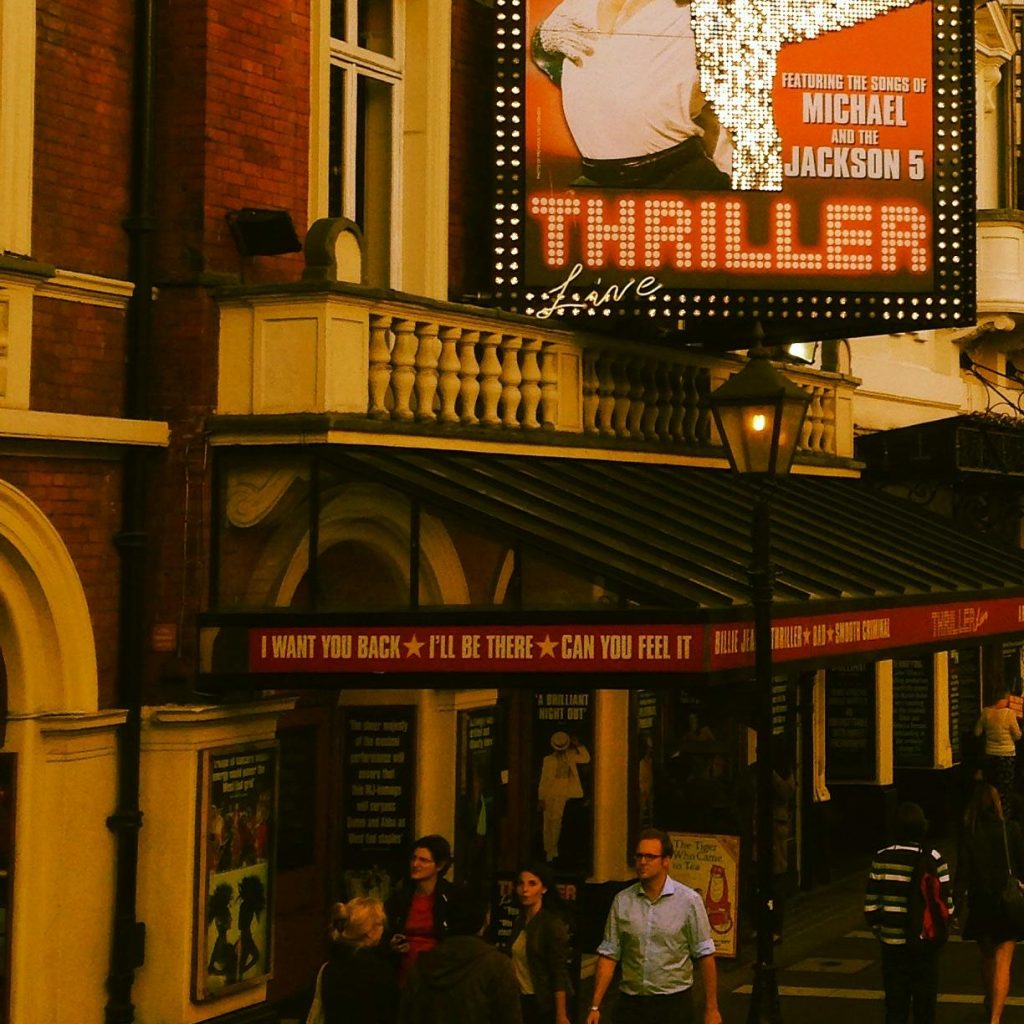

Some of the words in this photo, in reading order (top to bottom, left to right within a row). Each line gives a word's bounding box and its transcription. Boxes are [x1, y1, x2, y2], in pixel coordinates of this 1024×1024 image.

[782, 73, 844, 90] FEATURING
[847, 75, 867, 91] THE
[871, 76, 910, 93] SONGS
[914, 78, 926, 93] OF
[803, 93, 907, 127] MICHAEL
[831, 129, 855, 144] AND
[860, 130, 880, 145] THE
[785, 146, 900, 180] JACKSON
[908, 150, 925, 180] 5
[531, 195, 930, 273] THRILLER
[536, 263, 662, 320] Live
[715, 628, 738, 655] BILLIE
[741, 628, 756, 653] JEA
[771, 625, 802, 650] THRILLER
[835, 621, 861, 644] SMOOTH
[862, 617, 891, 641] CRIMINAL
[931, 608, 975, 638] THRILLER
[261, 635, 268, 659] I
[272, 634, 315, 659] WANT
[322, 634, 352, 659] YOU
[358, 634, 401, 659] BACK
[428, 634, 455, 659] I'LL
[461, 634, 481, 659] BE
[485, 634, 533, 659] THERE
[561, 634, 595, 659] CAN
[600, 634, 632, 659] YOU
[638, 634, 670, 659] FEEL
[676, 634, 692, 659] IT
[539, 707, 564, 721] NIGHT
[546, 693, 589, 706] BRILLIANT
